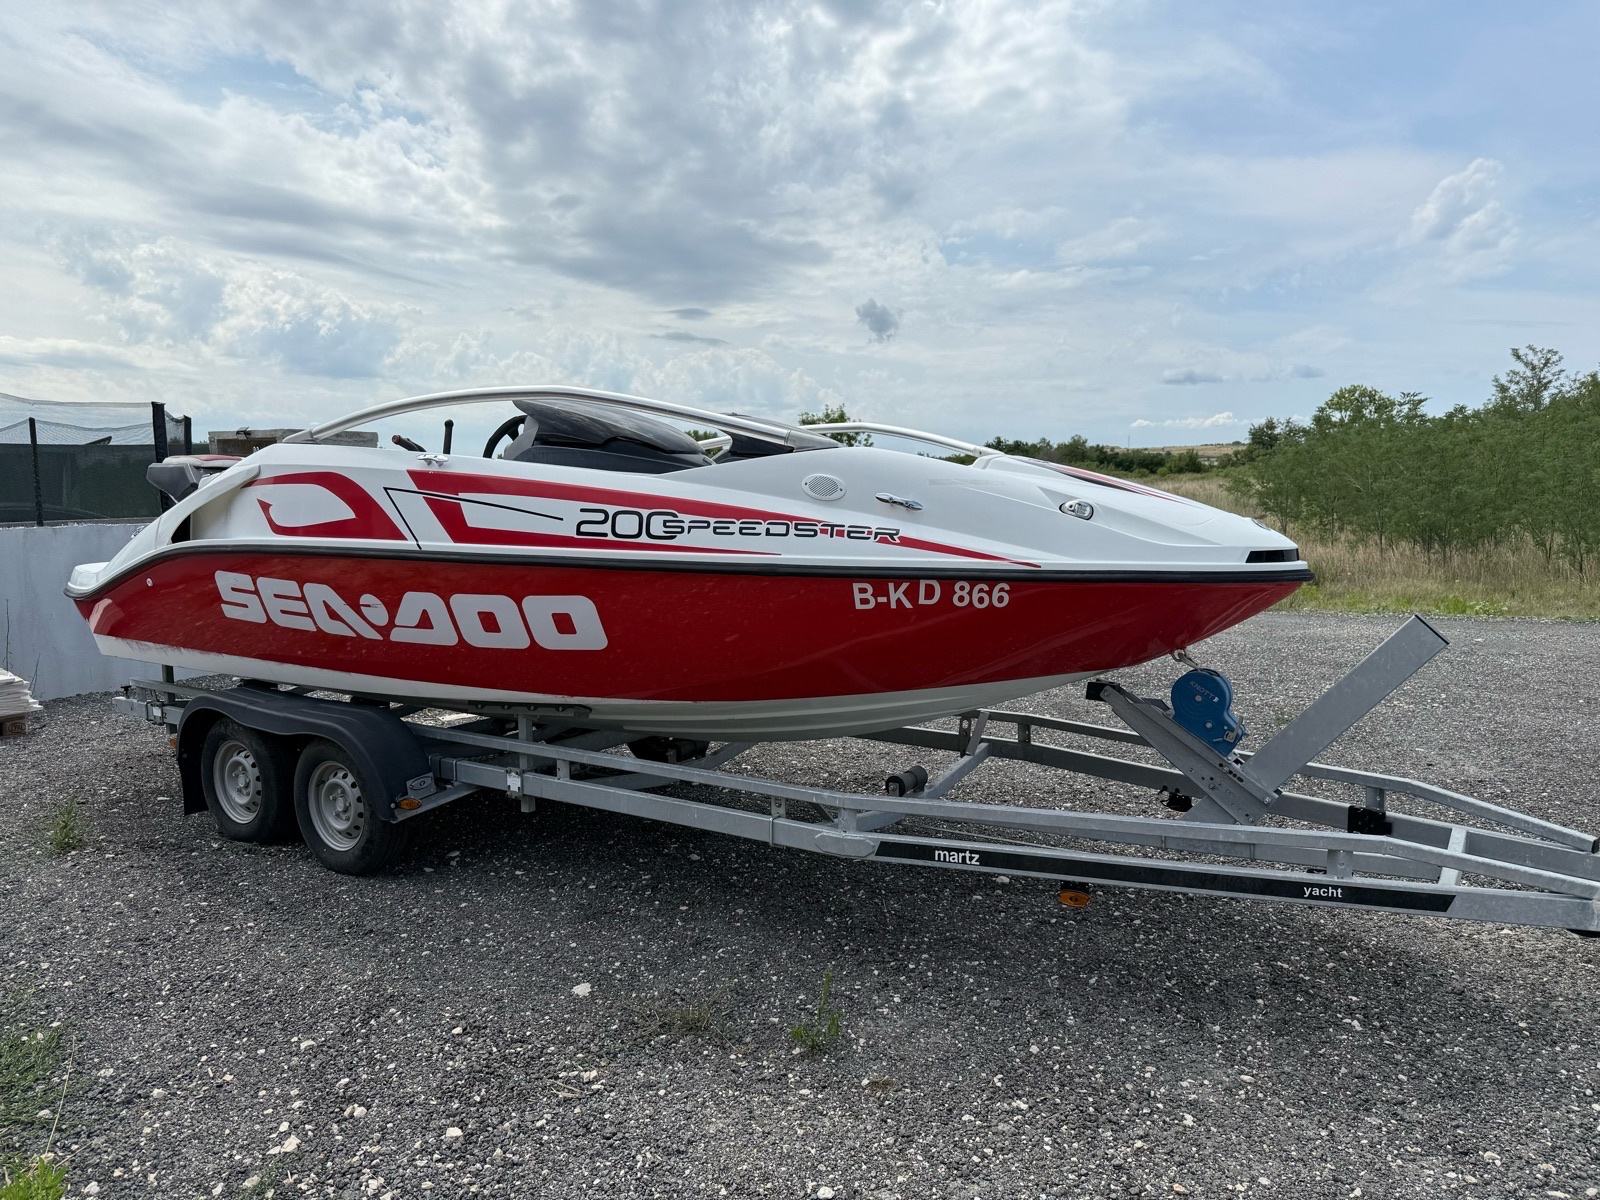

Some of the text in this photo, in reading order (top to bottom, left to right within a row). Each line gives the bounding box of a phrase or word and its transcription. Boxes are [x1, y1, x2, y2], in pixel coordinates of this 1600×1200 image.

[661, 518, 901, 543] SPEEDSTER
[952, 580, 1011, 609] 866
[934, 850, 980, 865] martz
[1303, 886, 1343, 898] yacht
